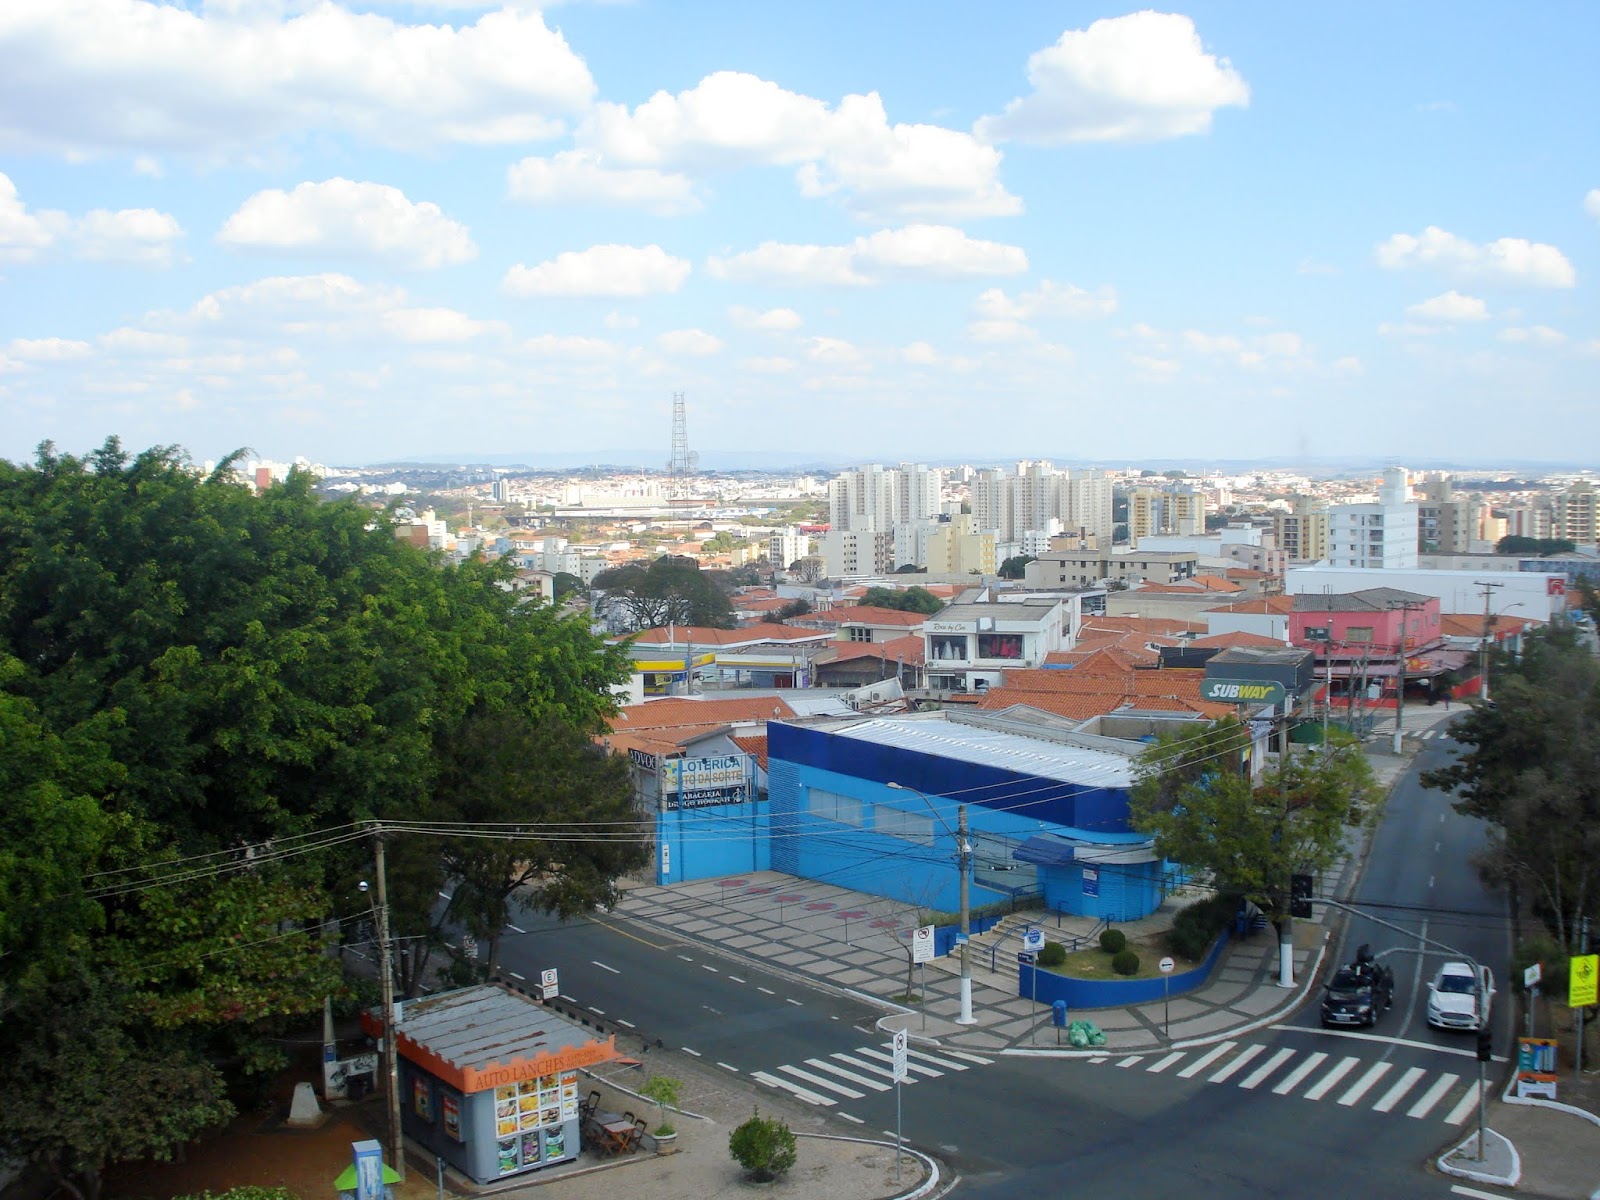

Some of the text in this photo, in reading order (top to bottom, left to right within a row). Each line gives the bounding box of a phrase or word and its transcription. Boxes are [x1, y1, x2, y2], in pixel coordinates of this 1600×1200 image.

[1208, 684, 1275, 699] SUBWAY
[664, 770, 743, 787] POTO DA SORTE
[678, 790, 721, 800] ABACARIA
[668, 800, 696, 808] DRGO
[476, 1069, 510, 1090] AUTO
[513, 1057, 564, 1081] LANCHES
